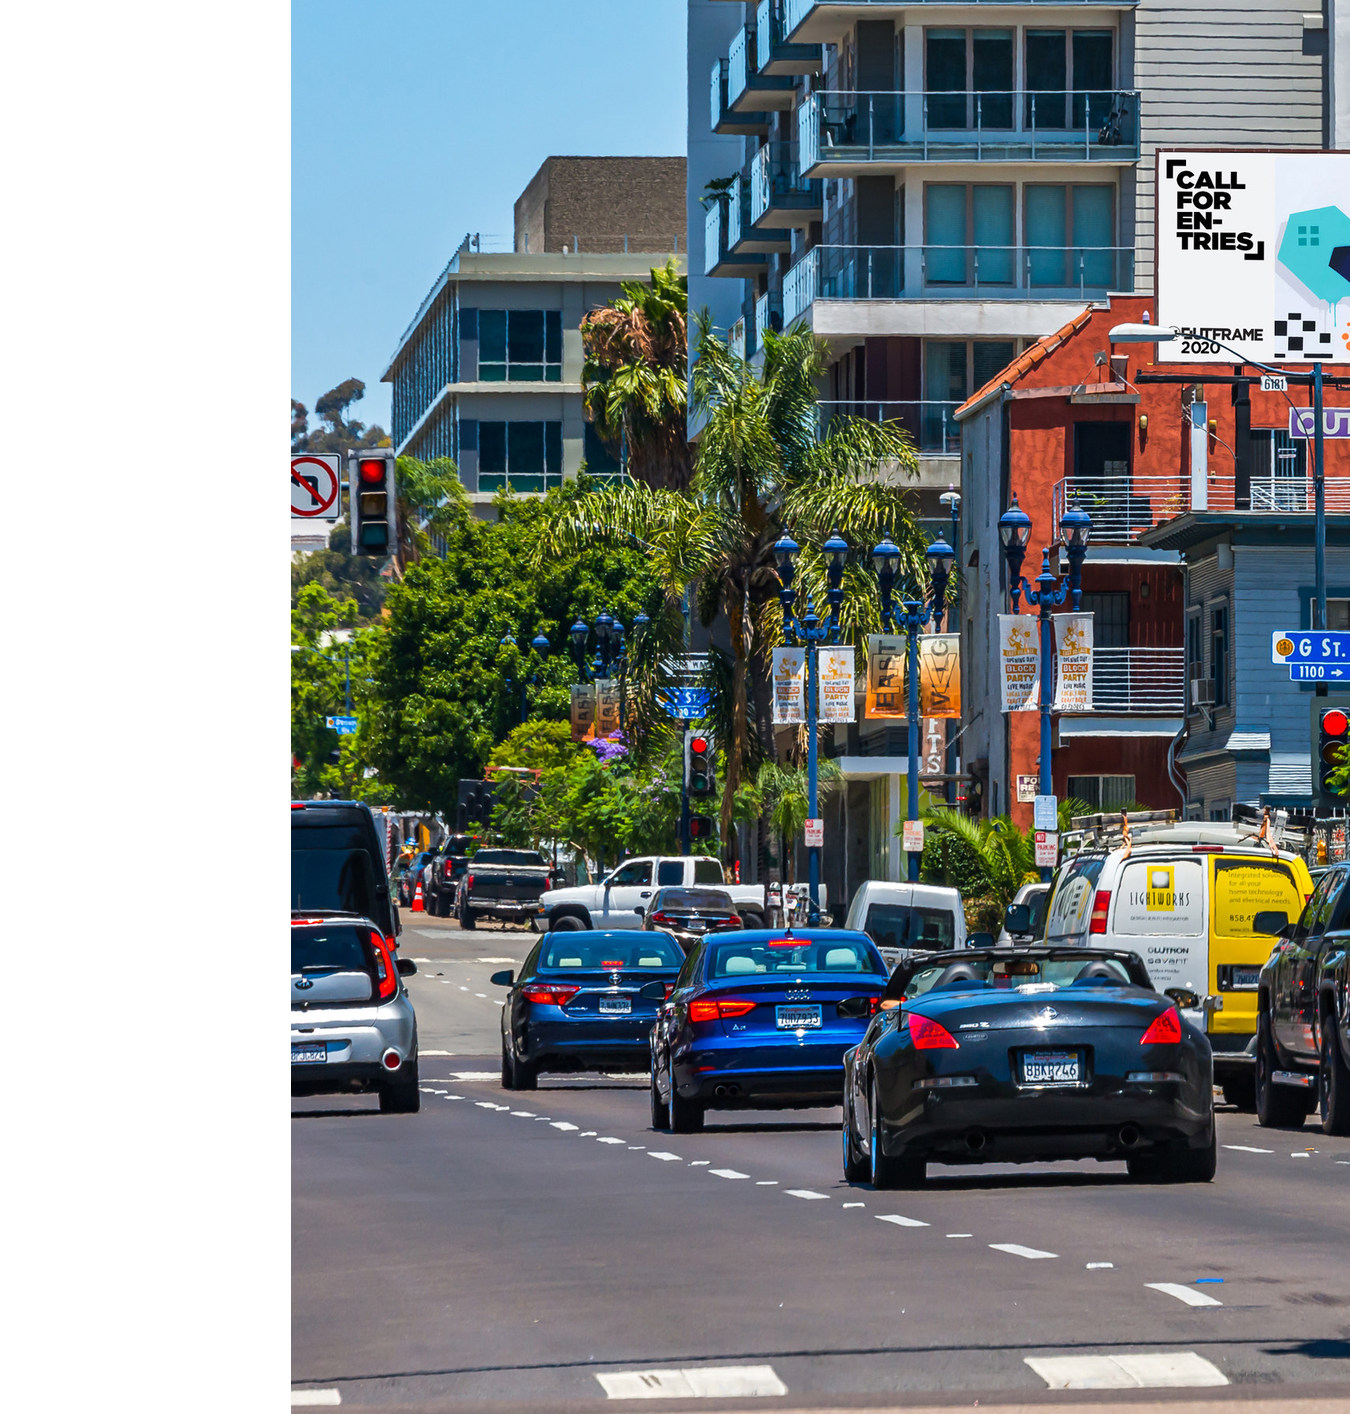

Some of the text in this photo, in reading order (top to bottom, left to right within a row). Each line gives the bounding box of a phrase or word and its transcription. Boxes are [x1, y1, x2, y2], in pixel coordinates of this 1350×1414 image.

[1176, 170, 1246, 190] CALL
[1177, 191, 1232, 210] FOR
[1177, 211, 1222, 230] EN-
[1176, 232, 1254, 251] TRIES
[1181, 341, 1221, 354] 2020
[1299, 638, 1312, 657] G
[1006, 664, 1035, 673] BLOCK
[1299, 665, 1325, 678] 1100
[1006, 674, 1035, 682] PARTY
[1023, 777, 1040, 785] FO
[1228, 871, 1260, 880] Integrated
[1130, 891, 1190, 907] LIGHTWORKS
[1248, 889, 1283, 897] technology
